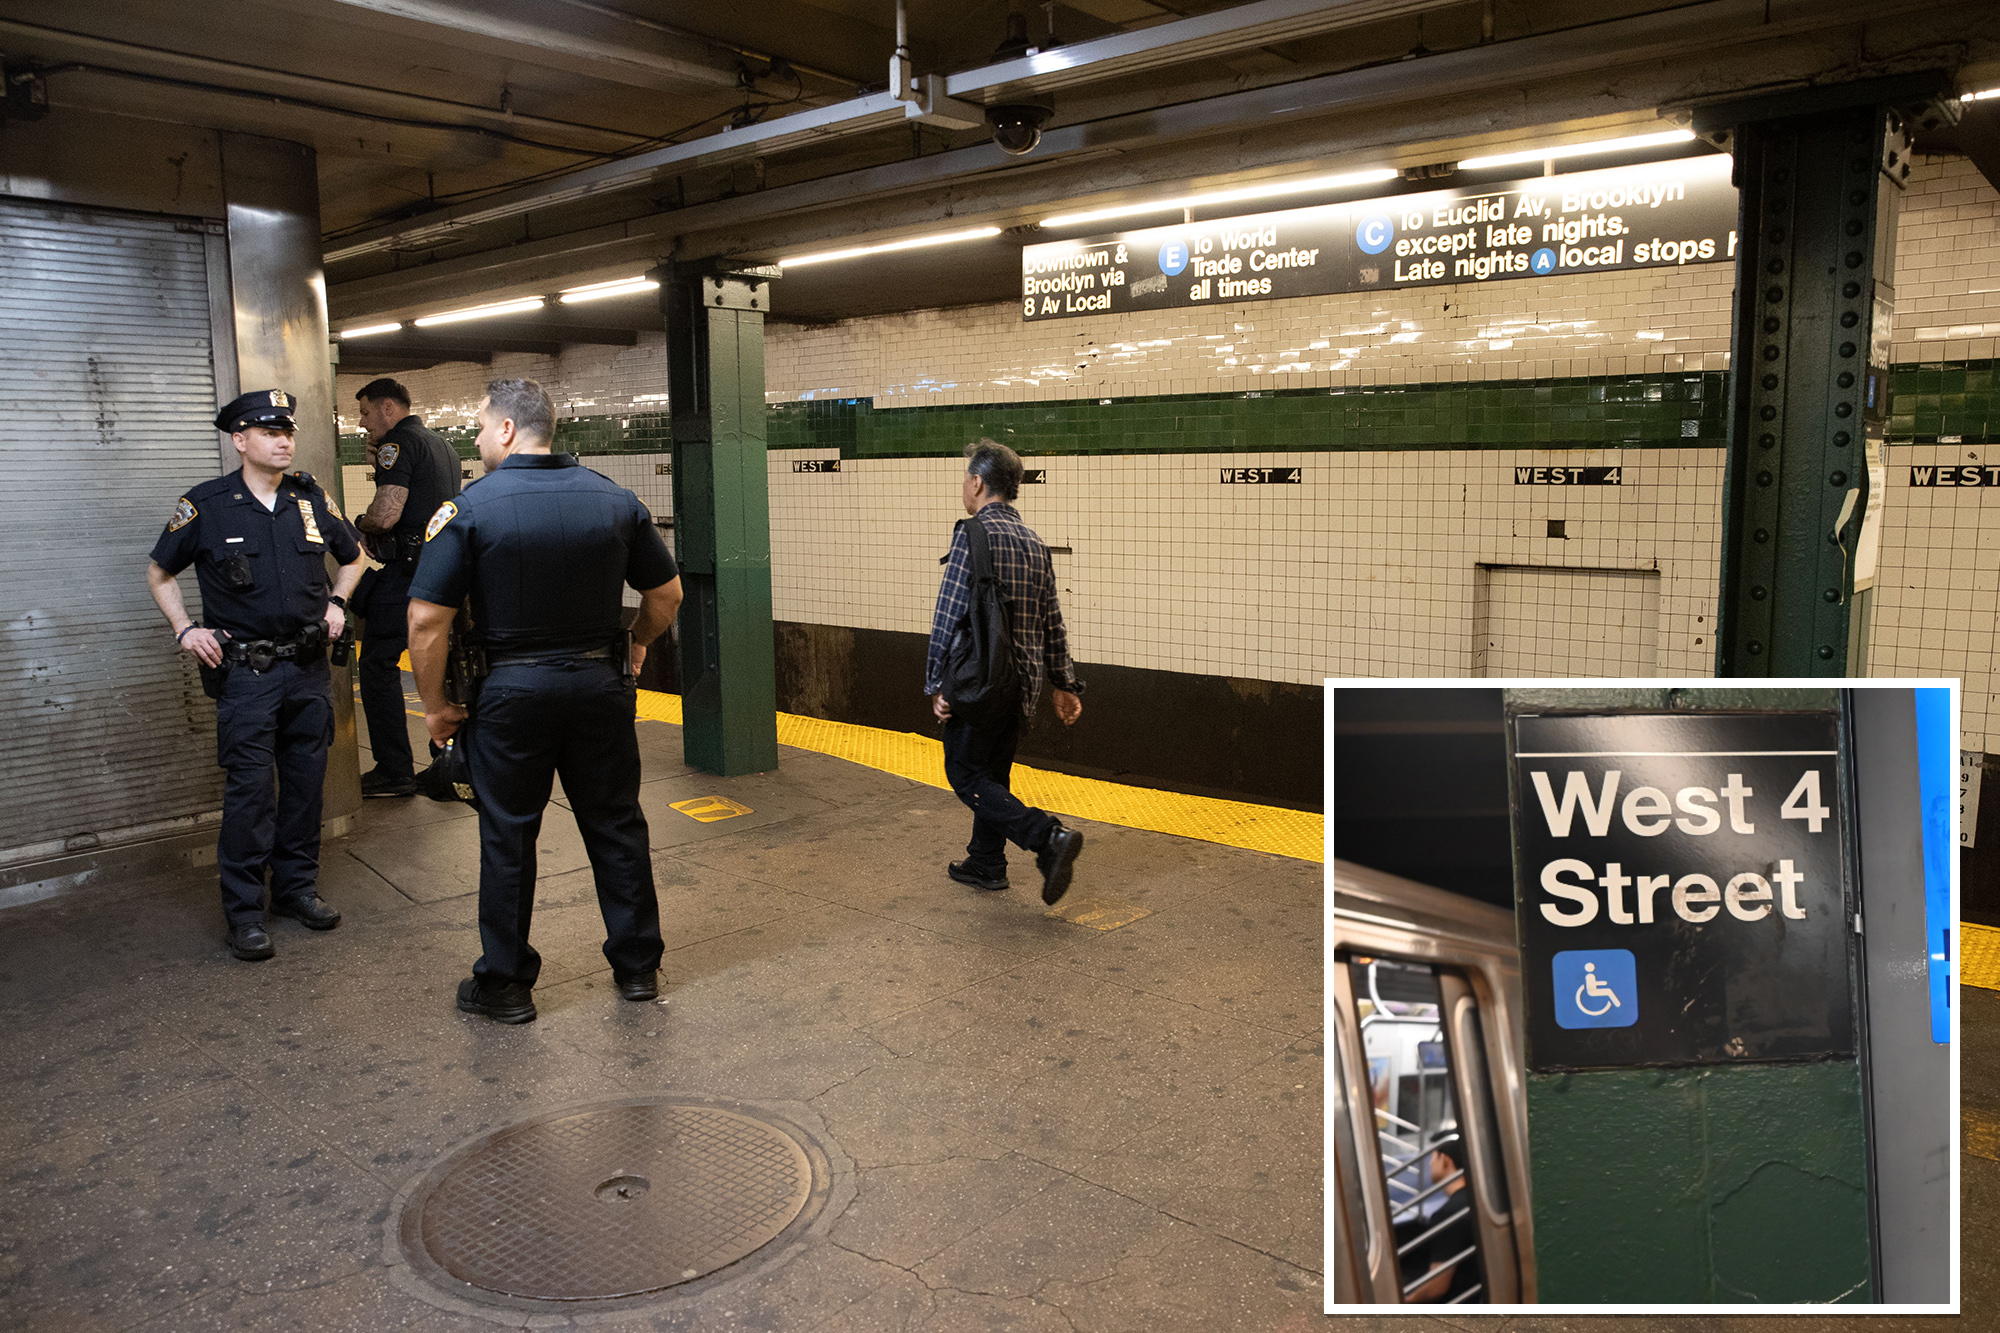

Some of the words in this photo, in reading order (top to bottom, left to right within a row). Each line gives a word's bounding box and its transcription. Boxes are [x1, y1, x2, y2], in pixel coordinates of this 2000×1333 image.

[1396, 208, 1423, 231] To
[1432, 196, 1505, 228] Euclid
[1513, 194, 1552, 220] Av,
[1561, 179, 1685, 213] Brooklyn
[1190, 234, 1213, 255] To
[1219, 225, 1277, 251] World
[1364, 221, 1384, 246] C
[1395, 227, 1477, 257] except
[1486, 223, 1532, 248] late
[1542, 213, 1629, 245] nights.
[1024, 250, 1109, 275] Downtown
[1115, 244, 1129, 264] &
[1166, 246, 1180, 268] E
[1189, 253, 1243, 277] Trade
[1249, 247, 1319, 272] Center
[1394, 258, 1446, 282] Late
[1454, 250, 1529, 280] nights
[1536, 252, 1550, 269] A
[1558, 239, 1623, 268] local
[1633, 237, 1716, 265] stops
[1024, 271, 1095, 295] Brooklyn
[1100, 267, 1125, 287] via
[1189, 278, 1211, 300] all
[1217, 276, 1272, 298] times
[1023, 297, 1036, 317] 8
[1040, 296, 1060, 315] Av
[1066, 289, 1111, 312] Local
[656, 463, 672, 475] WES
[793, 461, 824, 472] WEST
[832, 460, 841, 472] 4
[1035, 470, 1046, 484] 4
[1221, 468, 1273, 483] WEST
[1287, 468, 1300, 483] 4
[1516, 467, 1584, 485] WEST
[1603, 467, 1620, 485] 4
[1912, 466, 2000, 486] WEST
[1530, 769, 1755, 838] West
[1780, 769, 1830, 833] 4
[1538, 858, 1807, 928] Street
